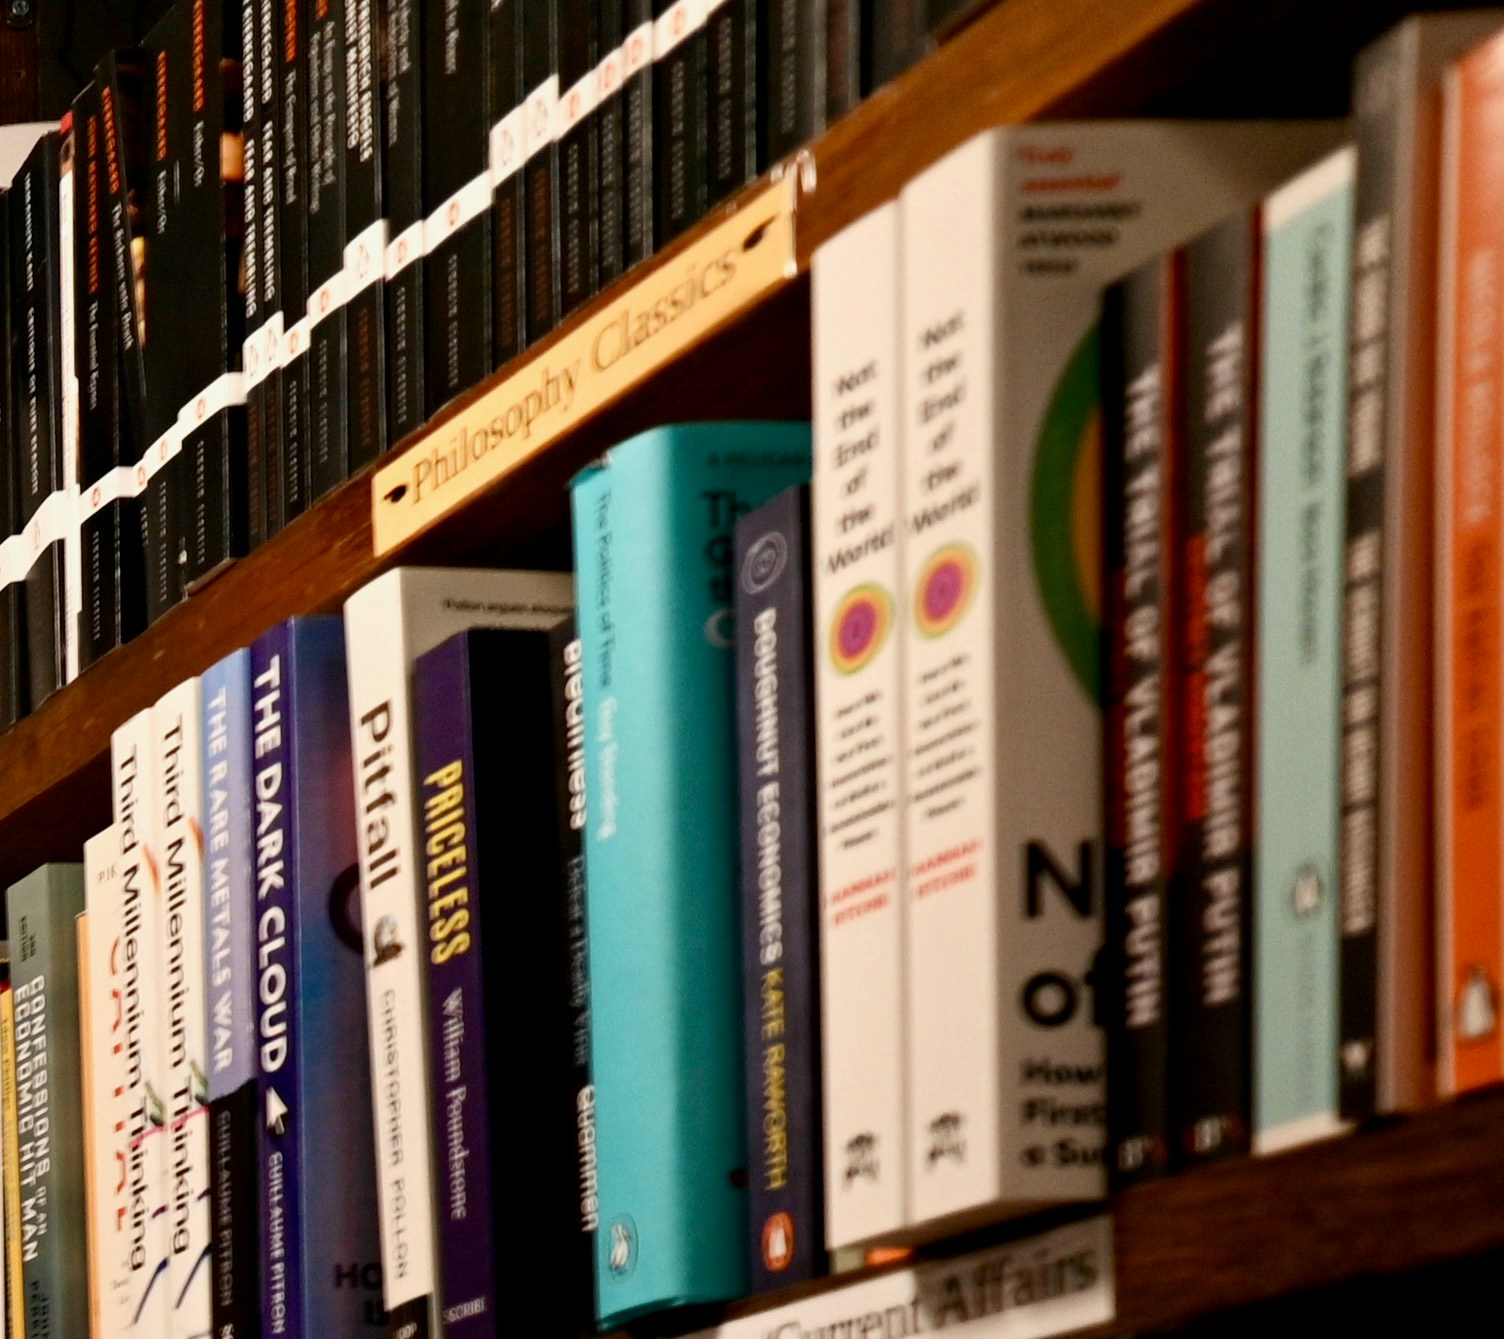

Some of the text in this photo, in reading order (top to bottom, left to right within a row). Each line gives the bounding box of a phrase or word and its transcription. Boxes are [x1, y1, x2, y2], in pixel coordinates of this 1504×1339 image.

[411, 249, 738, 502] Philosophy Classics
[251, 654, 289, 1074] THE DARK CLOUD
[359, 700, 399, 890] Pitfall
[424, 758, 472, 965] PRICELESS
[939, 1250, 1092, 1325] Affairs
